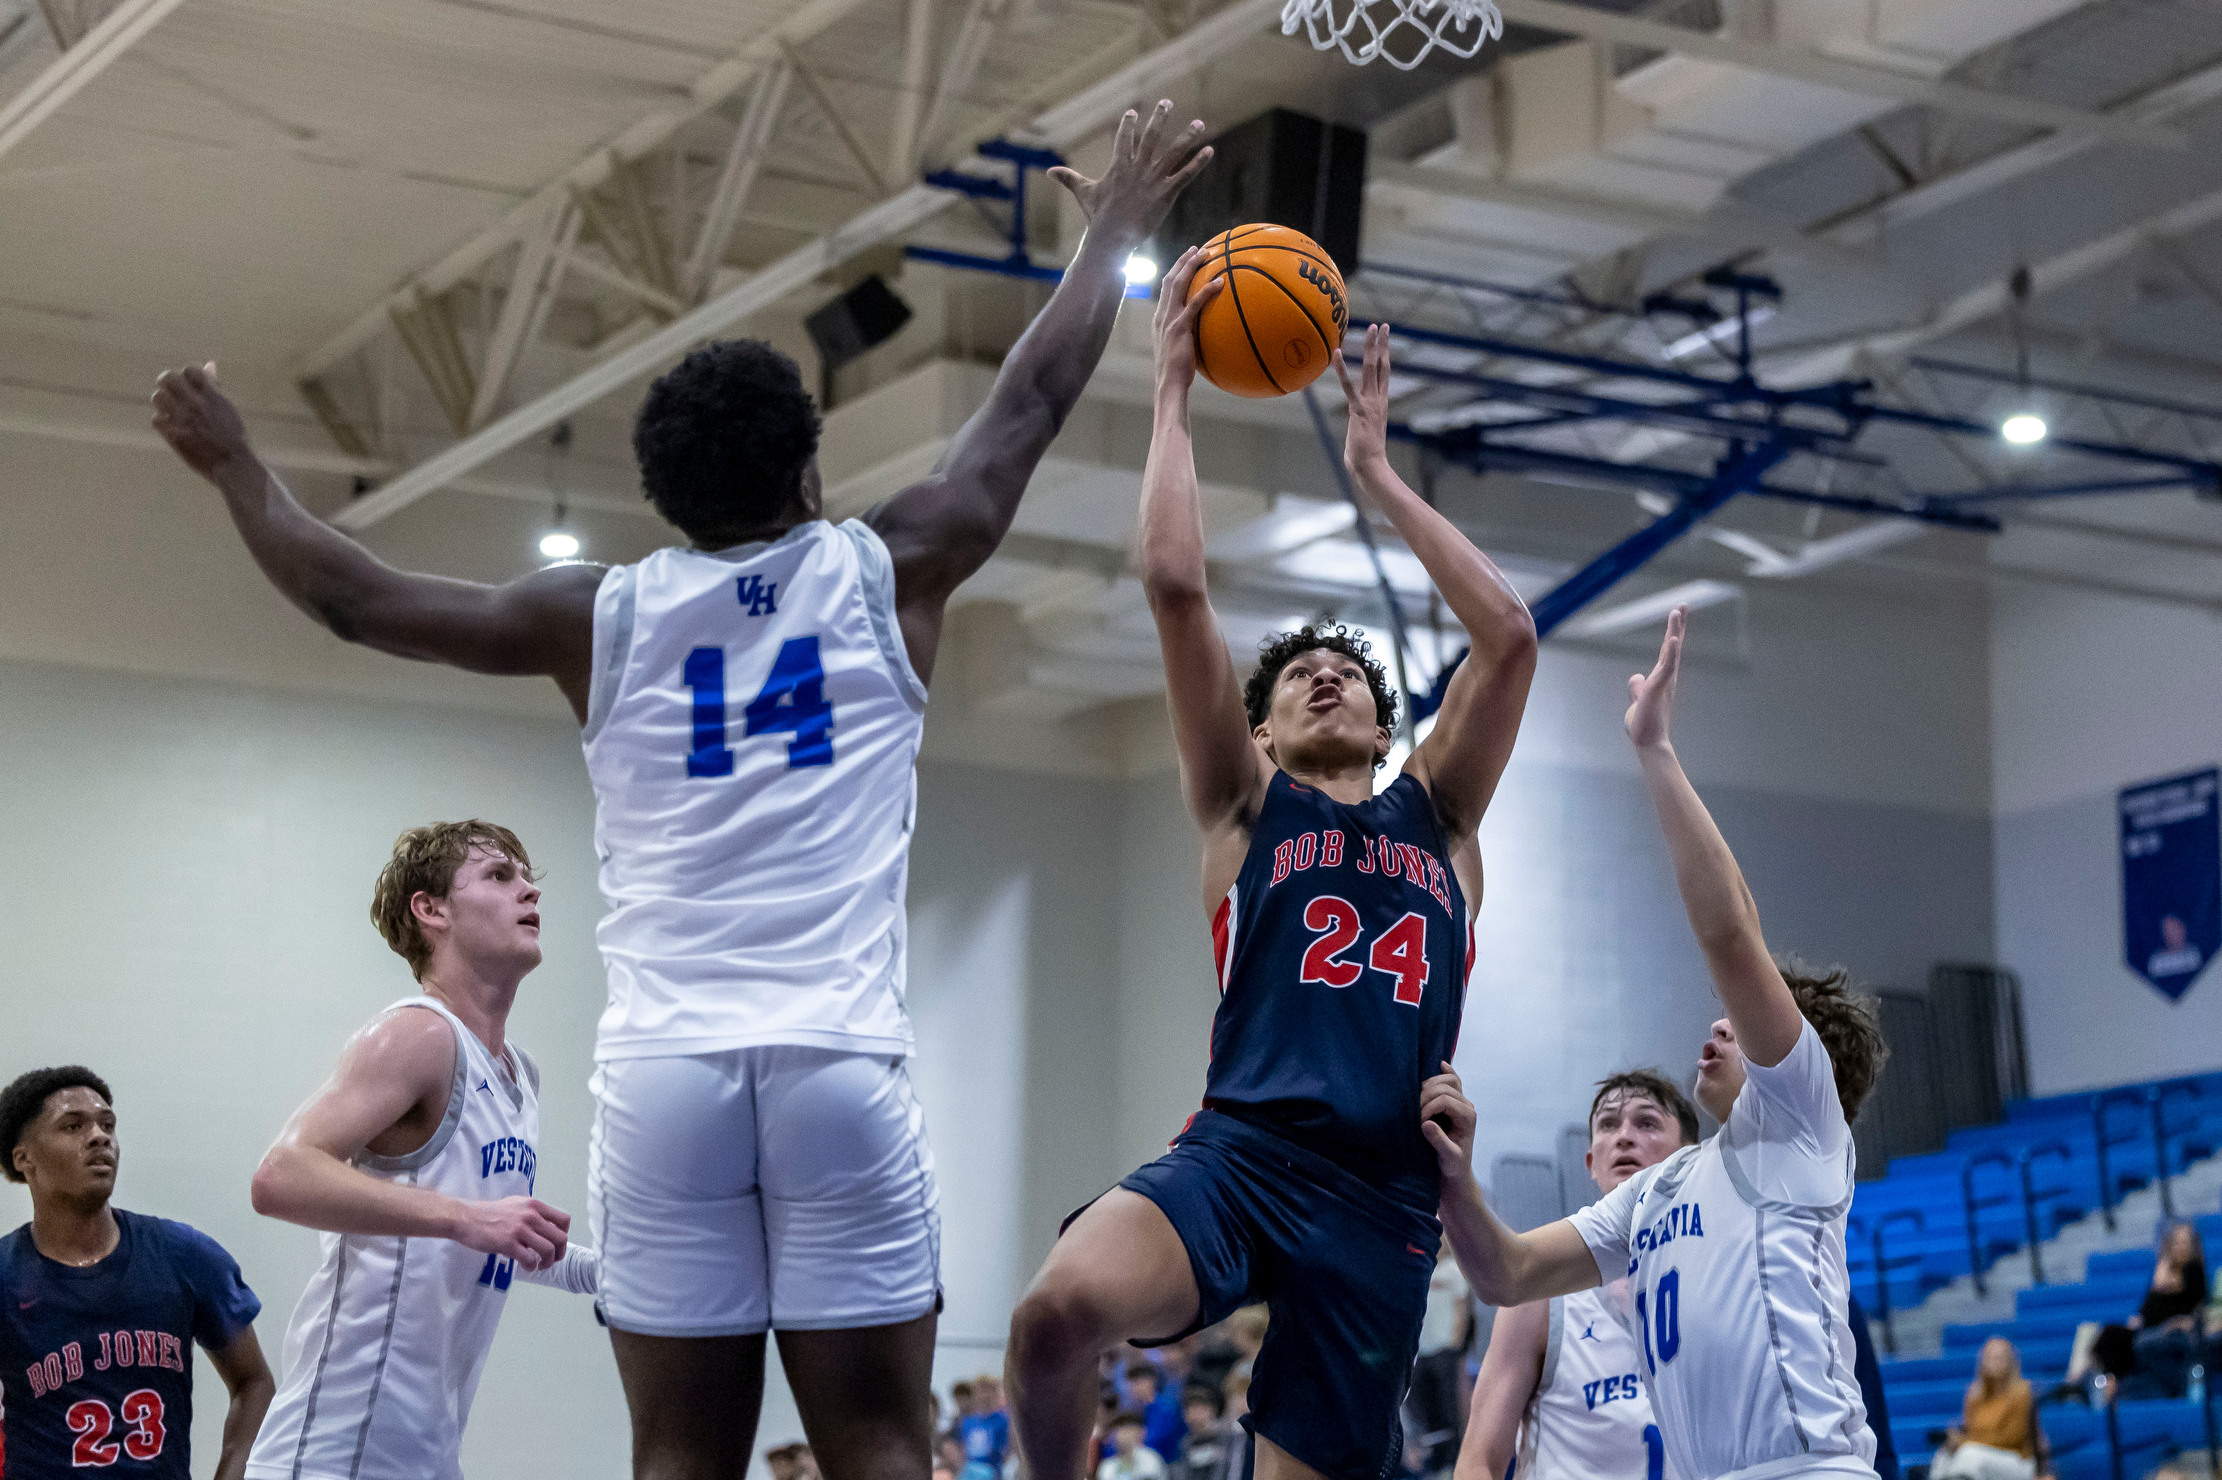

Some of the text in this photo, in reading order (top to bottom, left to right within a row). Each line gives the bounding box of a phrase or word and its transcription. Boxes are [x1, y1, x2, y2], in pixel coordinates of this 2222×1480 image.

[736, 574, 777, 617] VH
[684, 635, 834, 778] 14
[1269, 829, 1345, 889] BOB
[1300, 894, 1431, 1009] 24
[1635, 1266, 1682, 1378] 10
[26, 1329, 184, 1399] BOB JONES
[1582, 1373, 1643, 1412] VES
[65, 1388, 167, 1468] 23
